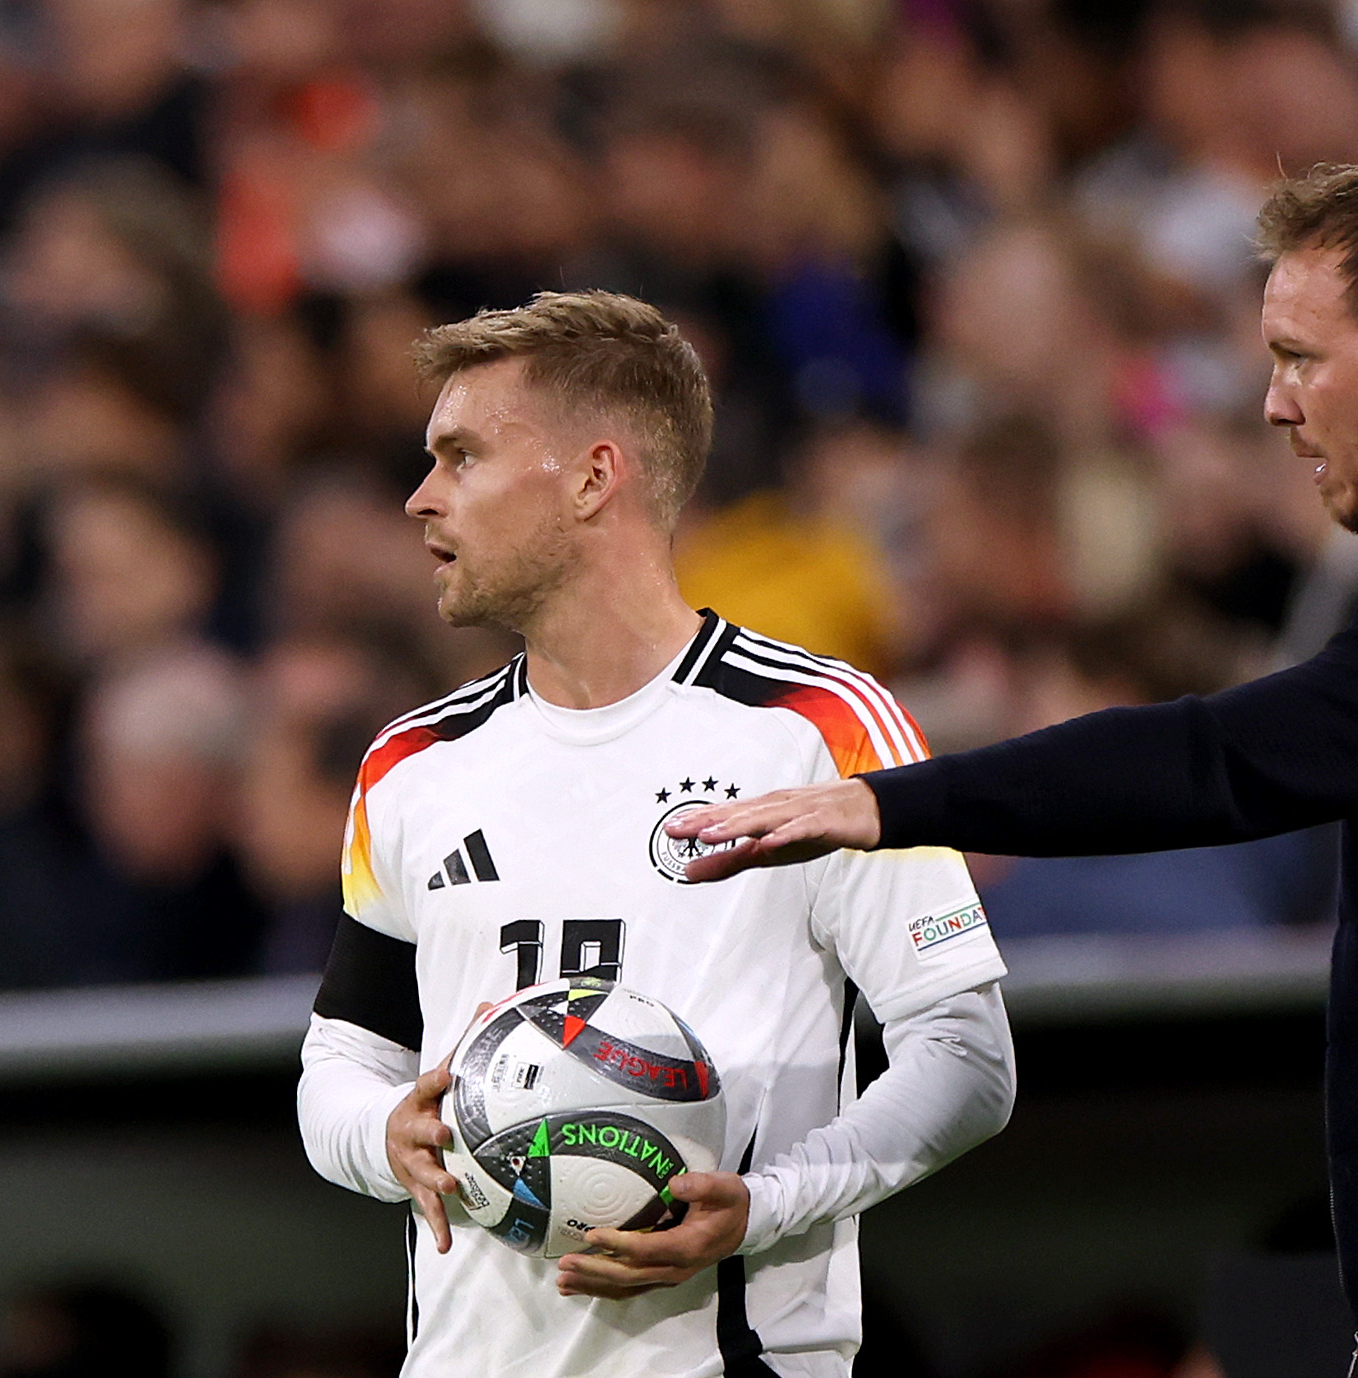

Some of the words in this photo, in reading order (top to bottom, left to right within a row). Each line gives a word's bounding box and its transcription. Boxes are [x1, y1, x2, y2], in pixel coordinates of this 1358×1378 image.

[908, 916, 935, 932] UEFA
[592, 1041, 689, 1090] LEAGUE
[561, 1123, 670, 1176] NATIONS
